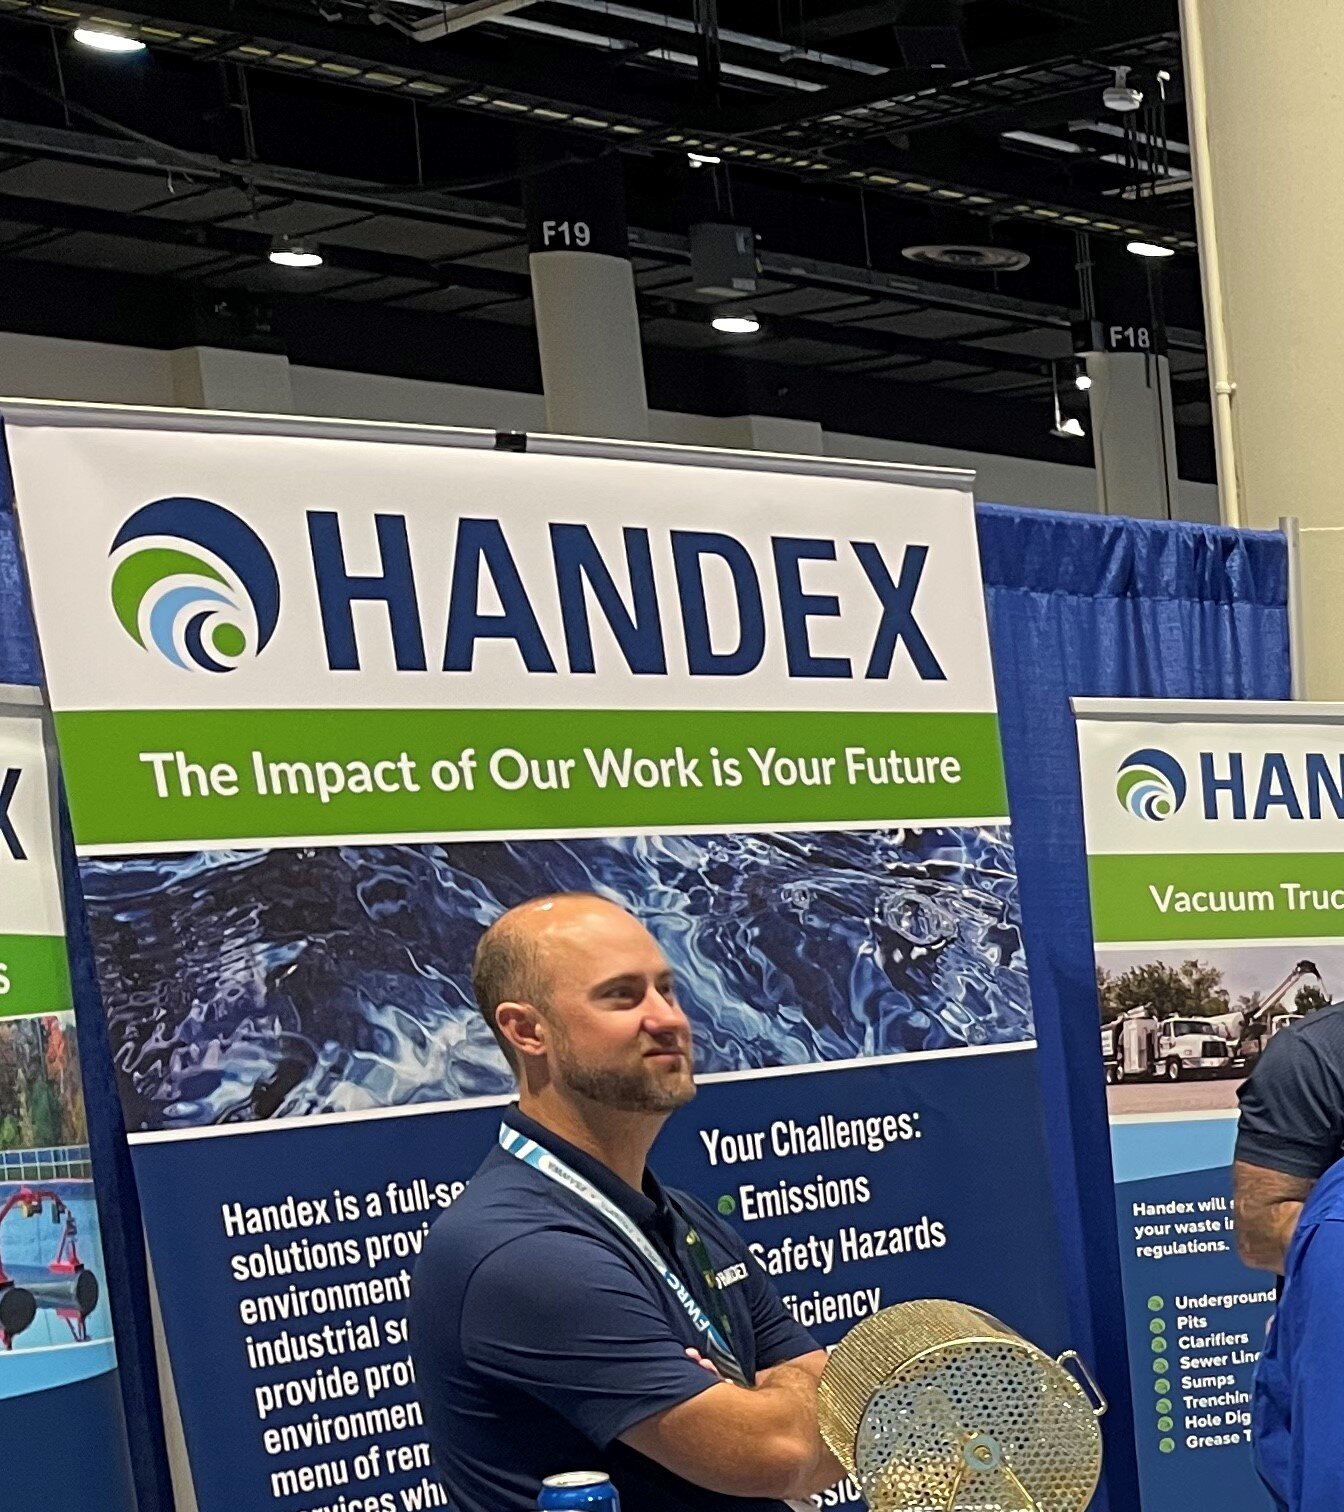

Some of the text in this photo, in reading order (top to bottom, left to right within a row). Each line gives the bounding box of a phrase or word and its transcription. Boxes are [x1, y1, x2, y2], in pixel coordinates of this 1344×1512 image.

[542, 221, 591, 248] F19
[1109, 326, 1150, 348] F18
[306, 508, 948, 682] HANDEX
[139, 741, 962, 802] The Impact of Our Work is Your Future
[1148, 885, 1275, 914] Vacuum
[700, 1111, 922, 1166] Your Challenges:
[739, 1174, 870, 1221] Emissions
[1132, 1199, 1195, 1218] Handex
[1198, 1196, 1228, 1212] will
[222, 1195, 331, 1238] Handex
[335, 1190, 360, 1221] is
[365, 1192, 382, 1217] a
[1134, 1223, 1170, 1240] your
[1174, 1217, 1221, 1235] waste
[231, 1236, 360, 1282] solutions
[749, 1215, 947, 1276] Safety Hazards
[1136, 1238, 1230, 1260] regulations.
[239, 1269, 411, 1326] environment
[1175, 1287, 1277, 1311] Underground
[1177, 1315, 1208, 1330] Pits
[246, 1317, 380, 1369] industrial
[1178, 1331, 1249, 1350] Clarifiers
[1179, 1354, 1228, 1371] Sewer
[255, 1365, 360, 1419] provide
[1181, 1372, 1236, 1392] Sumps
[1183, 1390, 1252, 1410] Trenchin
[263, 1400, 424, 1455] environmen
[1185, 1413, 1222, 1430] Hole
[1186, 1431, 1242, 1450] Grease
[271, 1457, 348, 1498] menu
[354, 1448, 381, 1481] of
